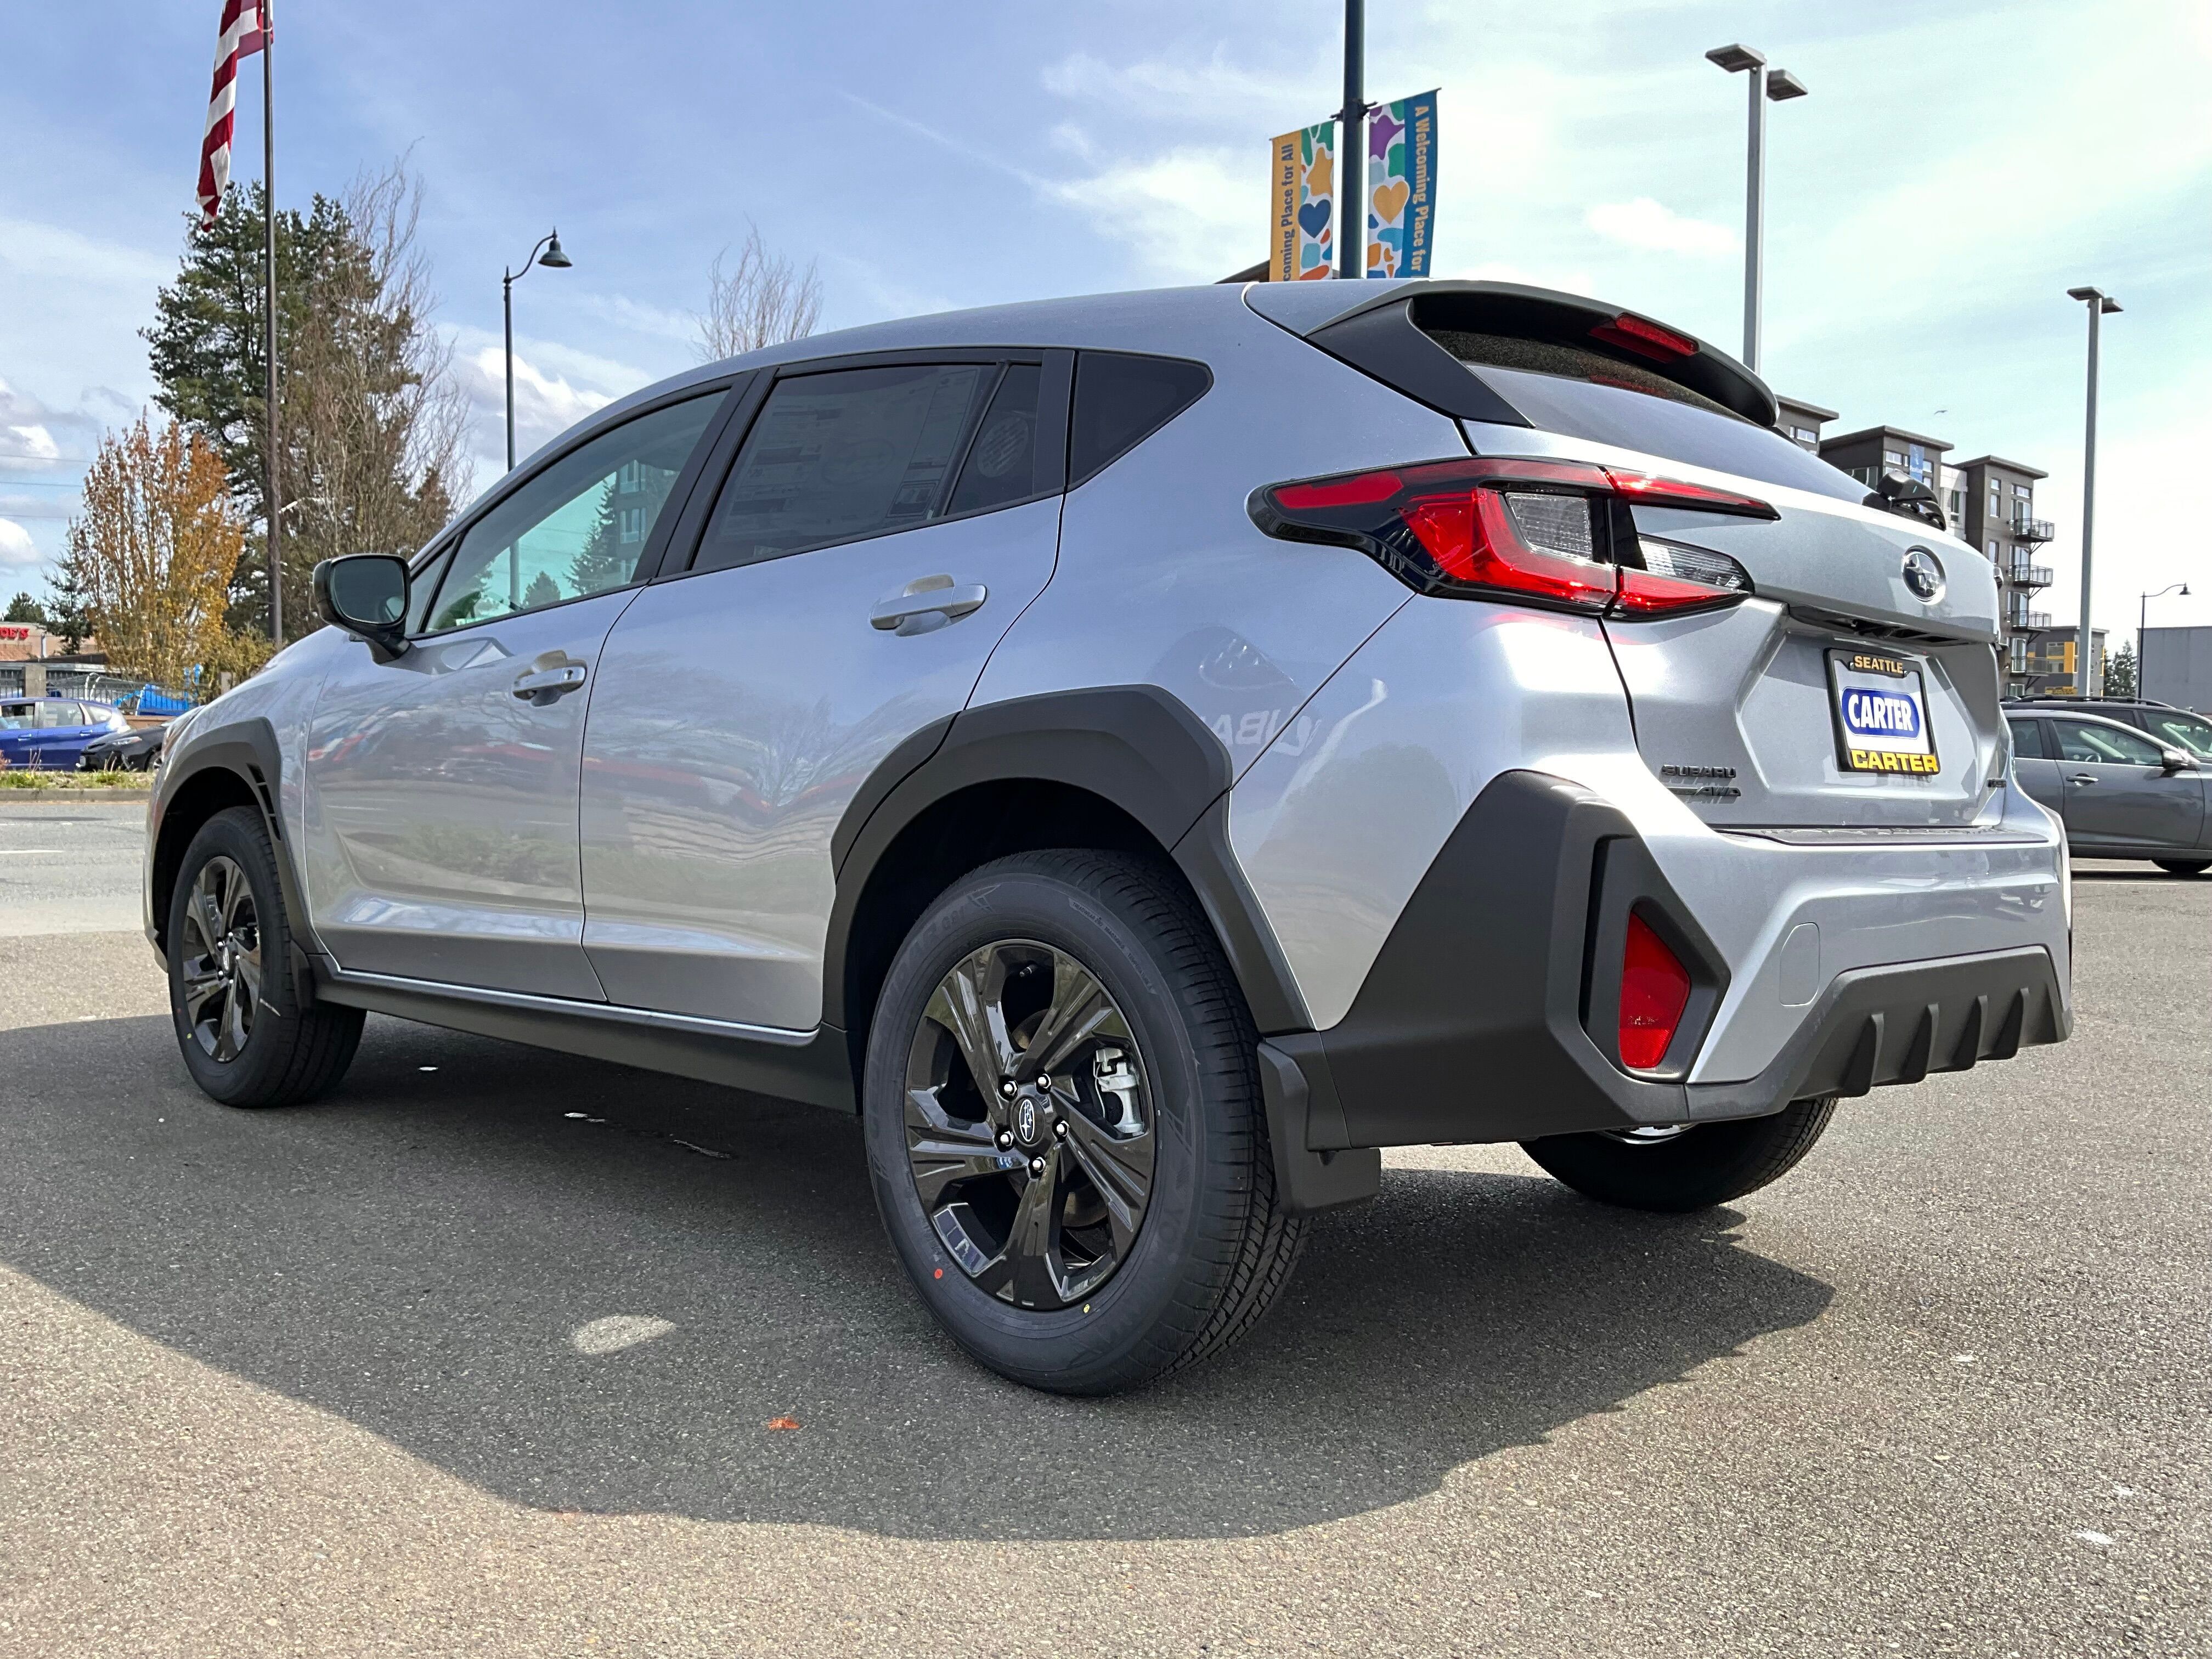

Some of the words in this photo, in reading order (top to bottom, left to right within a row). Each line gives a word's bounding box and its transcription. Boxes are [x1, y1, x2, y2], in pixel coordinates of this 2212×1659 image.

[1415, 106, 1429, 117] A
[1282, 143, 1294, 161] All
[1412, 121, 1430, 204] Welcoming
[1282, 165, 1294, 188] for
[1281, 190, 1294, 228] Place
[1413, 205, 1429, 247] Place
[1411, 249, 1426, 272] for
[0, 628, 29, 640] OE'S
[1854, 655, 1904, 674] SEATTLE
[1848, 693, 1914, 731] CARTER
[1661, 764, 1737, 778] SUBARU
[1851, 749, 1939, 772] CARTER
